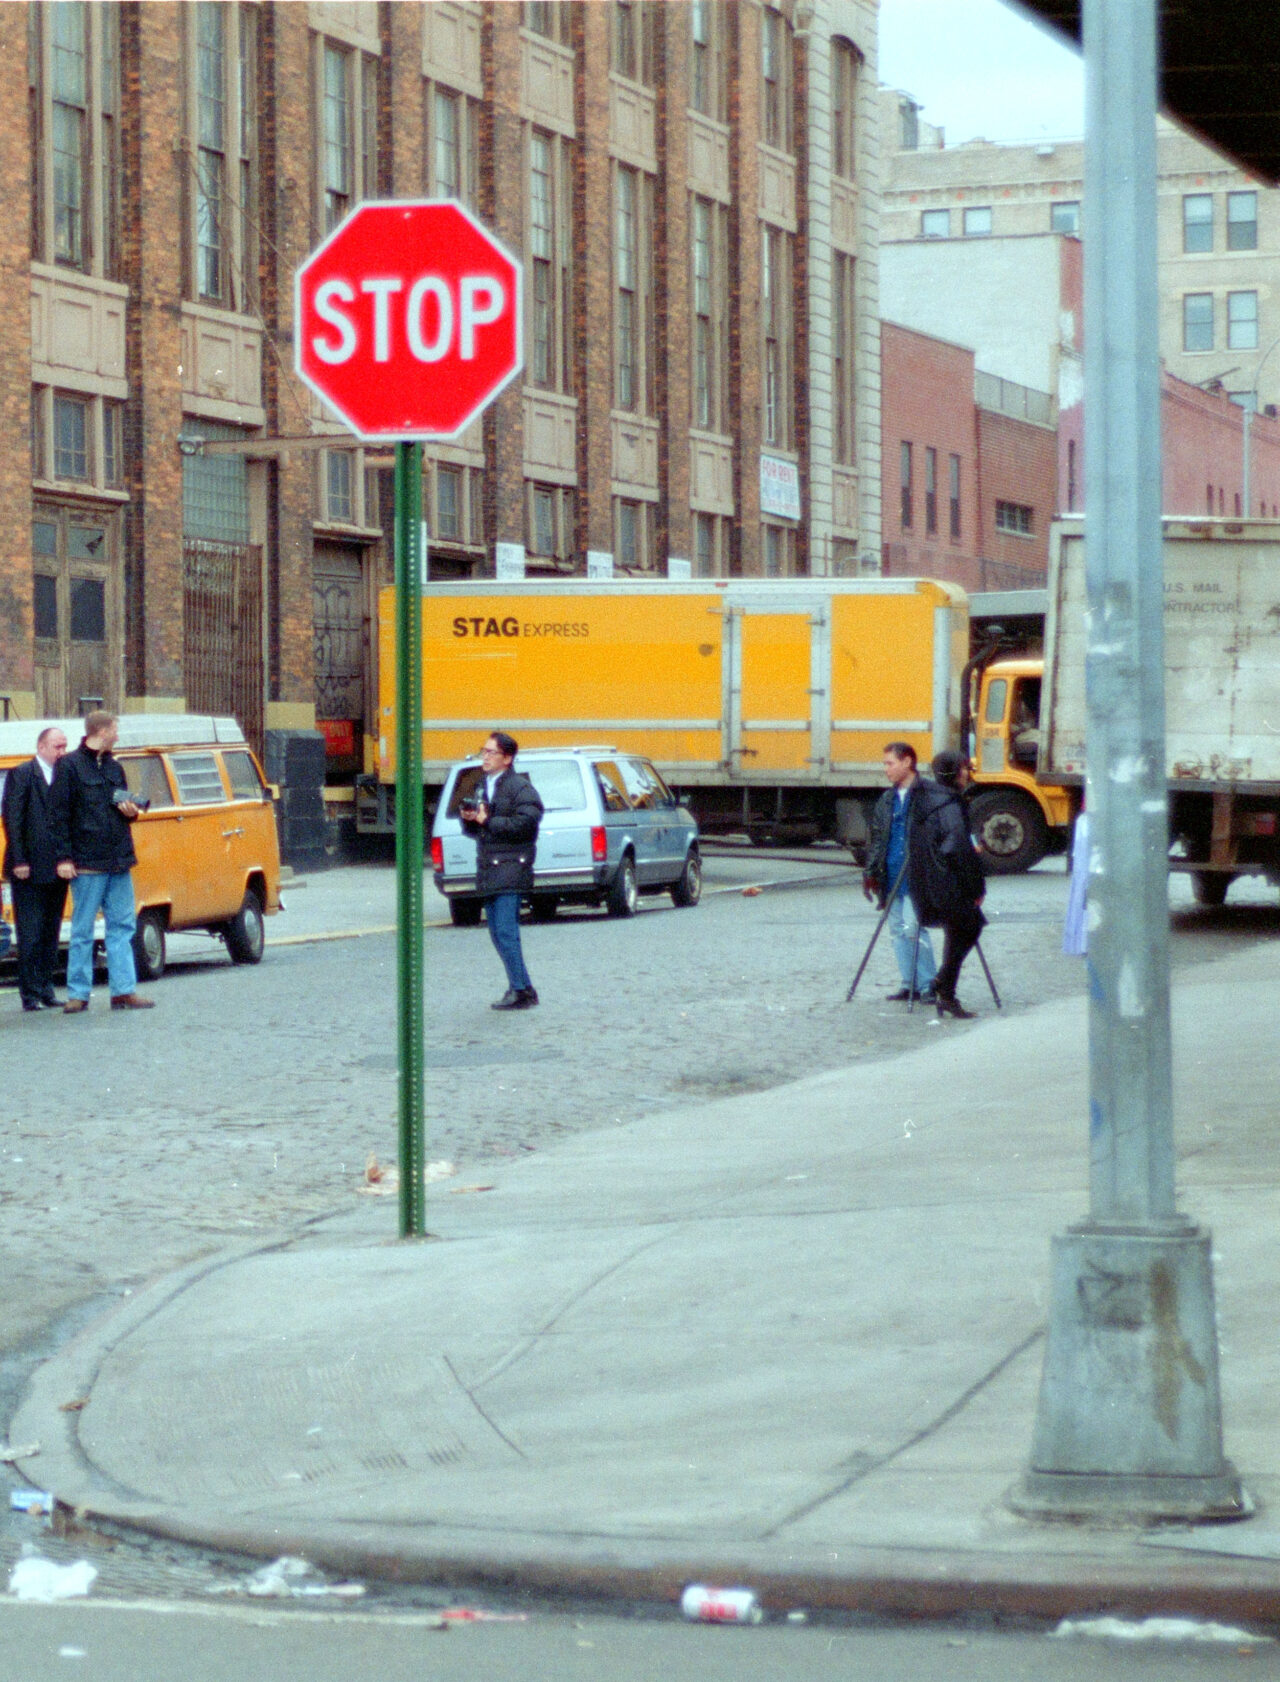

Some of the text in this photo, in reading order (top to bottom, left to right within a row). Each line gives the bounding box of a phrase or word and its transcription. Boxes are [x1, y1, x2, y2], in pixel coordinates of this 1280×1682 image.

[313, 277, 505, 364] STOP
[1193, 582, 1224, 593] MAIL
[1162, 602, 1235, 613] ONTRACTOR
[452, 616, 589, 637] STAG EXPRESS
